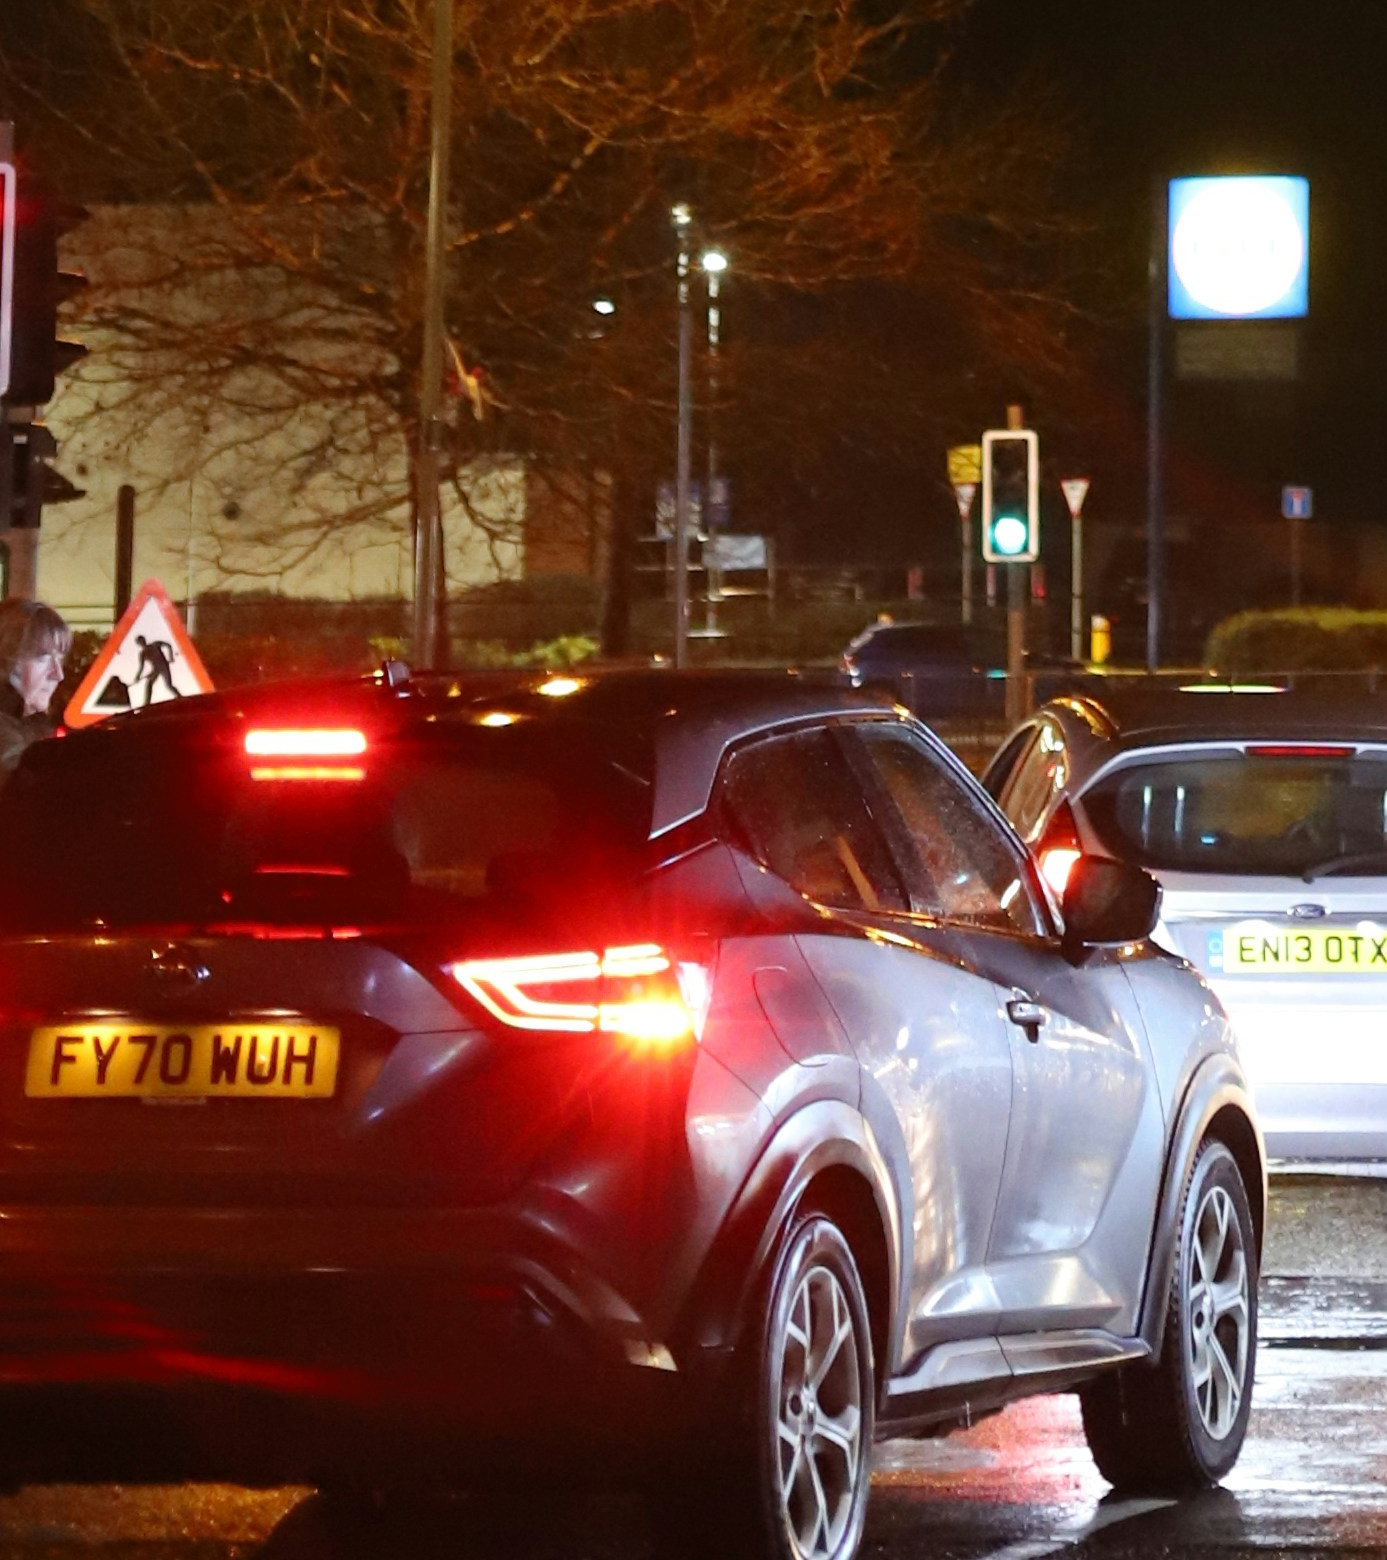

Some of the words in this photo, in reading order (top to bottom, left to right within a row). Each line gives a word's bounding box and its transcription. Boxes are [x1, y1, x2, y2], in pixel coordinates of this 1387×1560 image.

[1239, 936, 1312, 963] EN13
[51, 1035, 193, 1085] FY70
[210, 1035, 317, 1085] WUH
